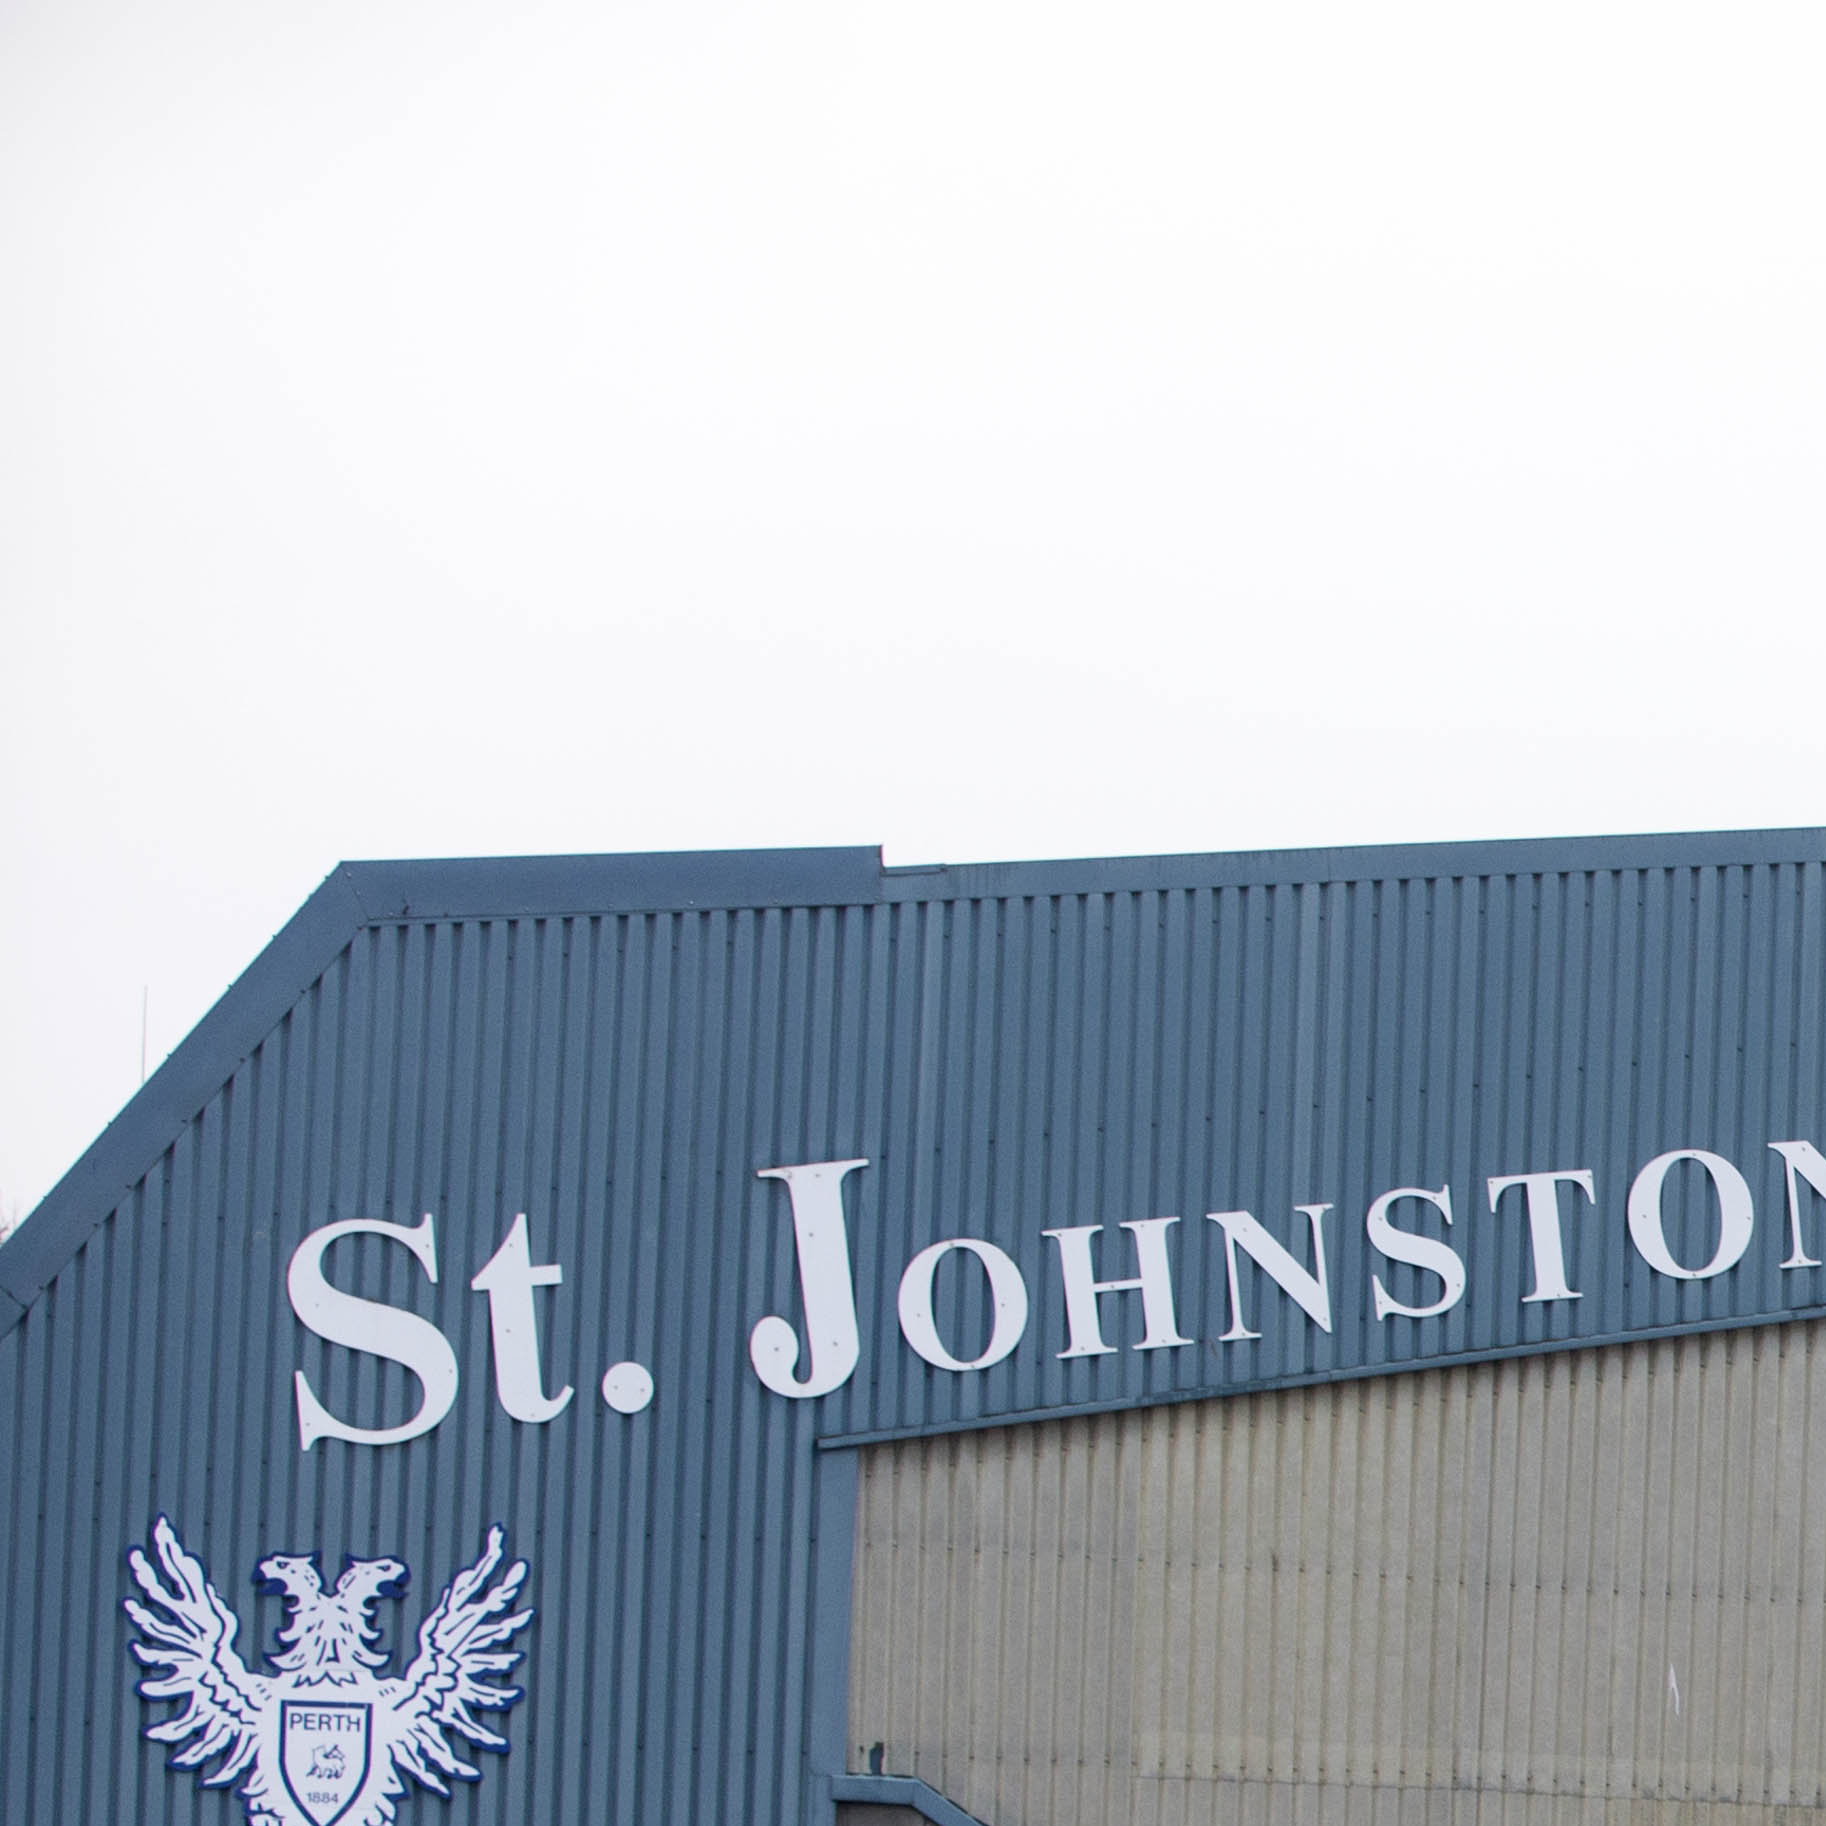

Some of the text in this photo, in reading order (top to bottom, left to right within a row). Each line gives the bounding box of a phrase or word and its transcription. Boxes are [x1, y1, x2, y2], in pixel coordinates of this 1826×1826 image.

[288, 1213, 654, 1451] St.
[289, 1712, 361, 1733] PERTH
[306, 1791, 339, 1804] 1884
